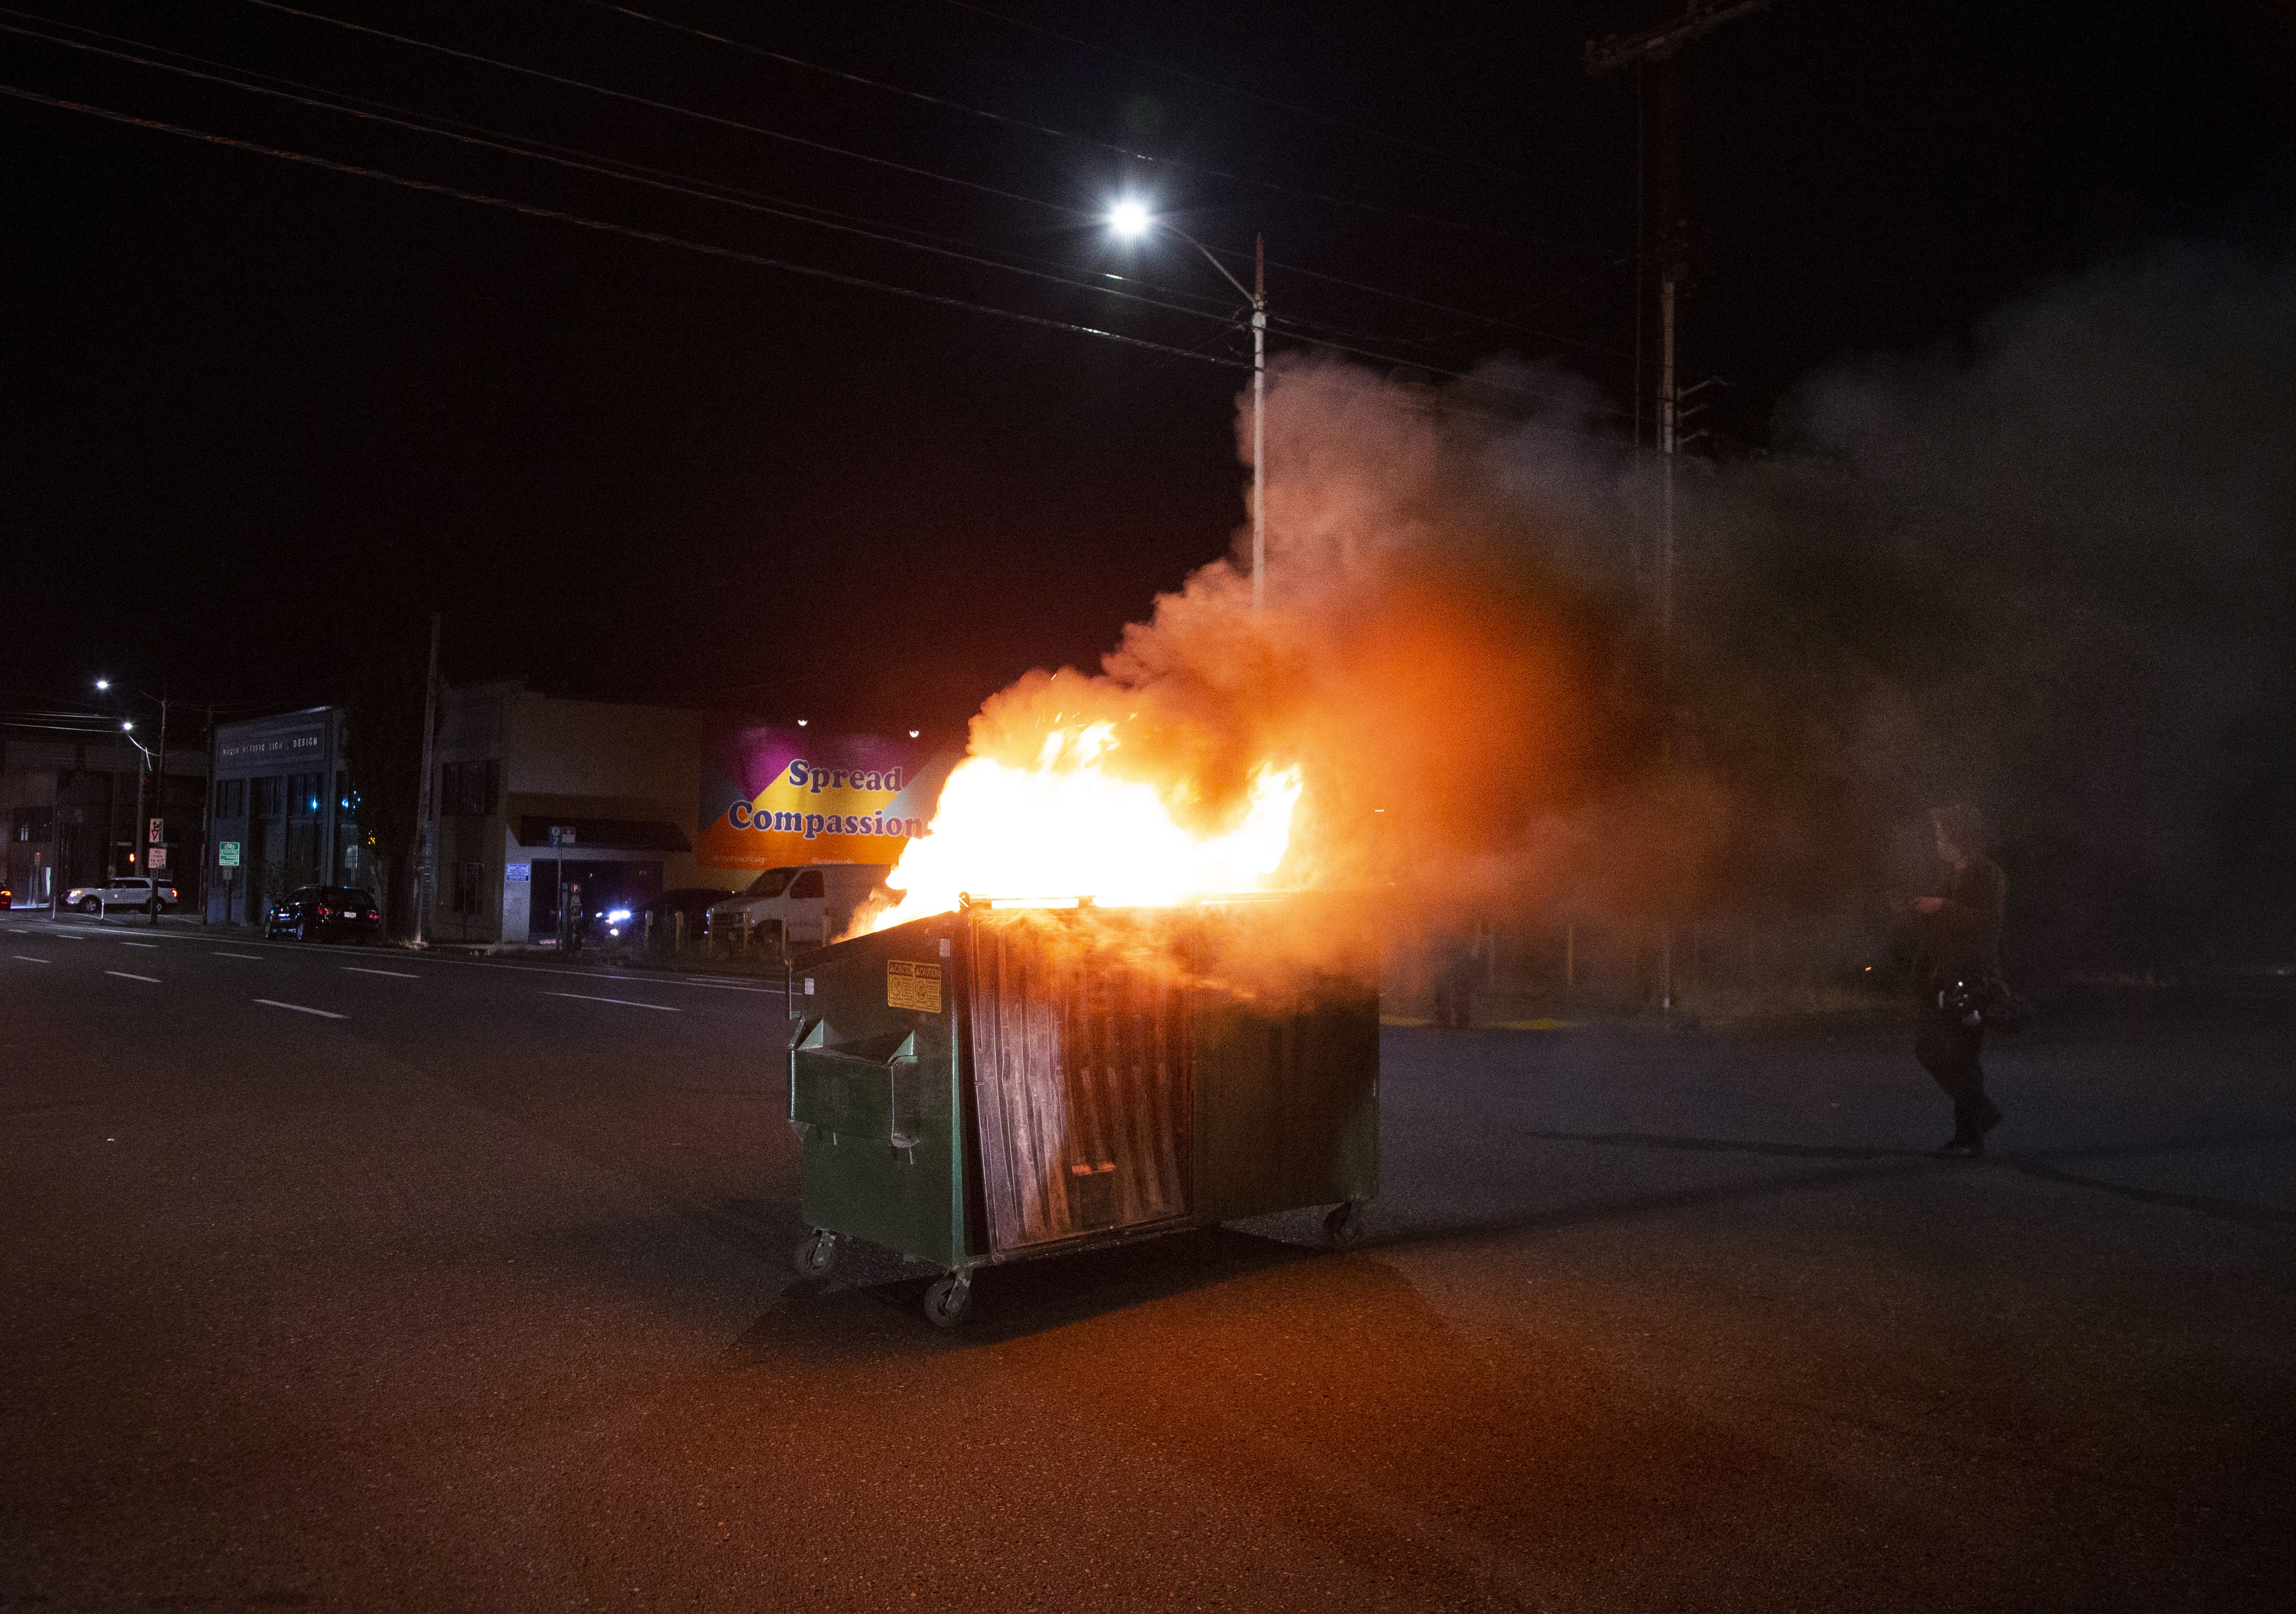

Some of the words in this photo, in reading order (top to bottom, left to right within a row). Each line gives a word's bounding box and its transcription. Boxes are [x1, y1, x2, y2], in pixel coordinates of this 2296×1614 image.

[269, 741, 282, 751] SIGN
[293, 737, 317, 748] DESIGN
[789, 759, 903, 794] Spread
[728, 799, 923, 840] Compassion
[919, 967, 941, 978] CAUTION
